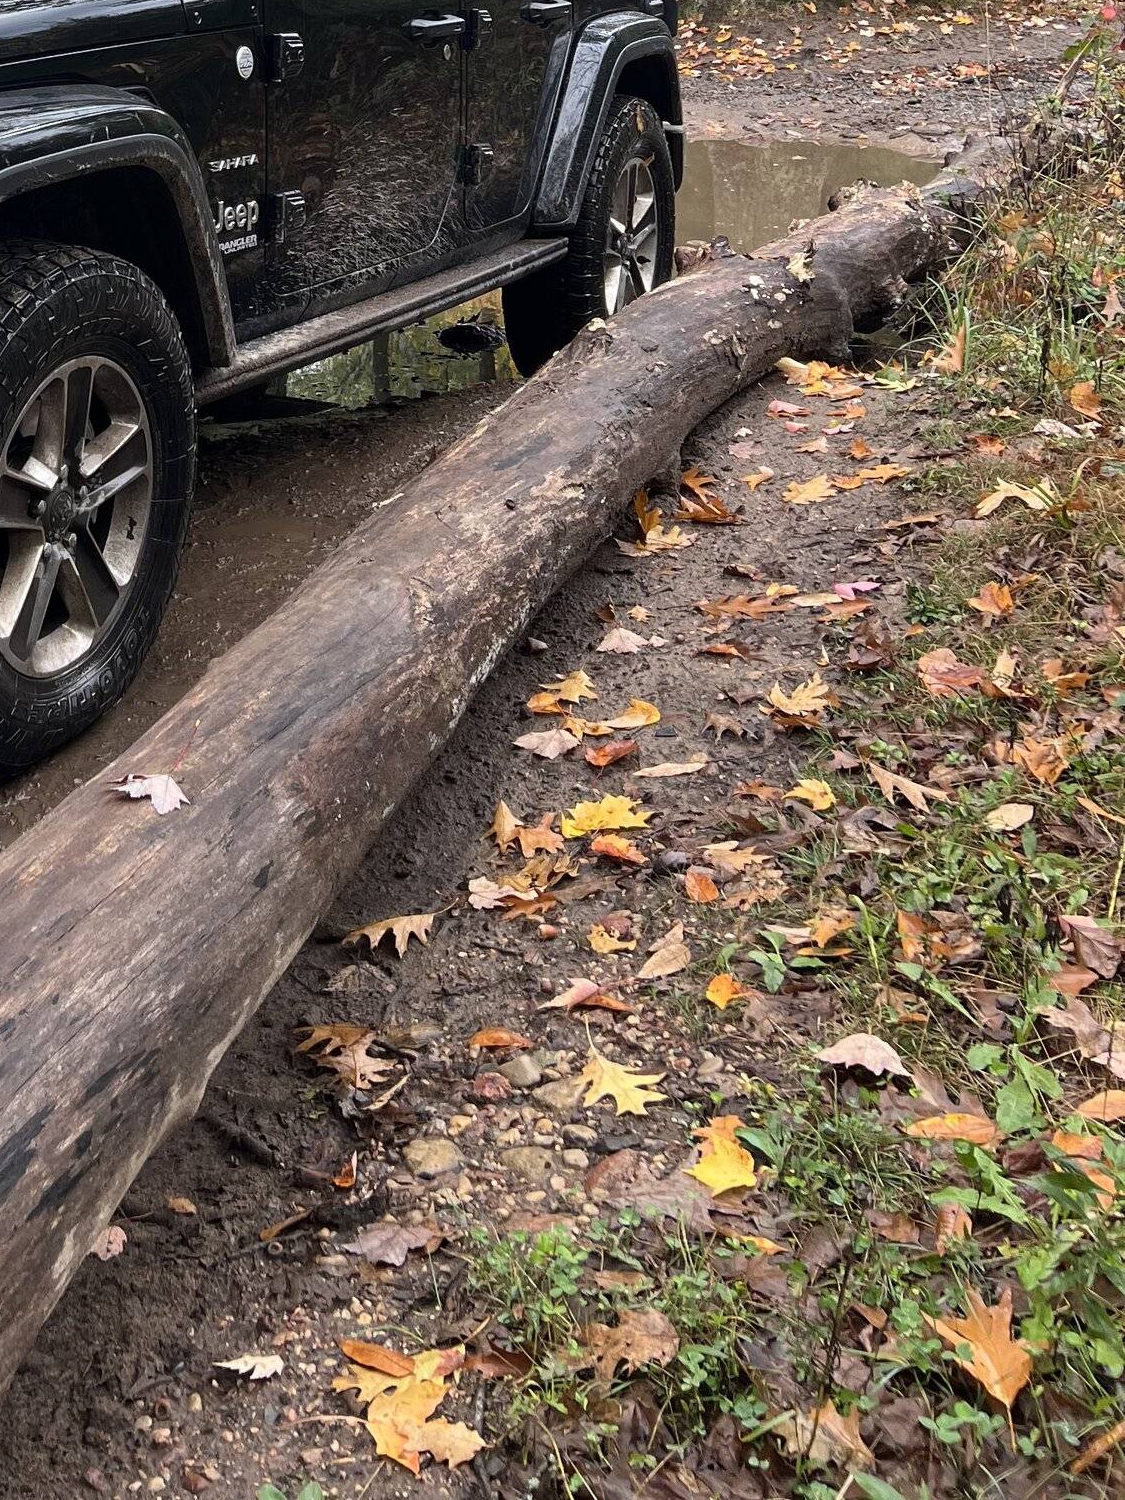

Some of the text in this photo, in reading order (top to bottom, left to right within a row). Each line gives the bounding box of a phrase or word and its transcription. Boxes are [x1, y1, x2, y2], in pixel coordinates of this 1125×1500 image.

[208, 154, 259, 172] SAHARA
[213, 200, 259, 234] Jeep
[218, 234, 257, 251] RANGLER
